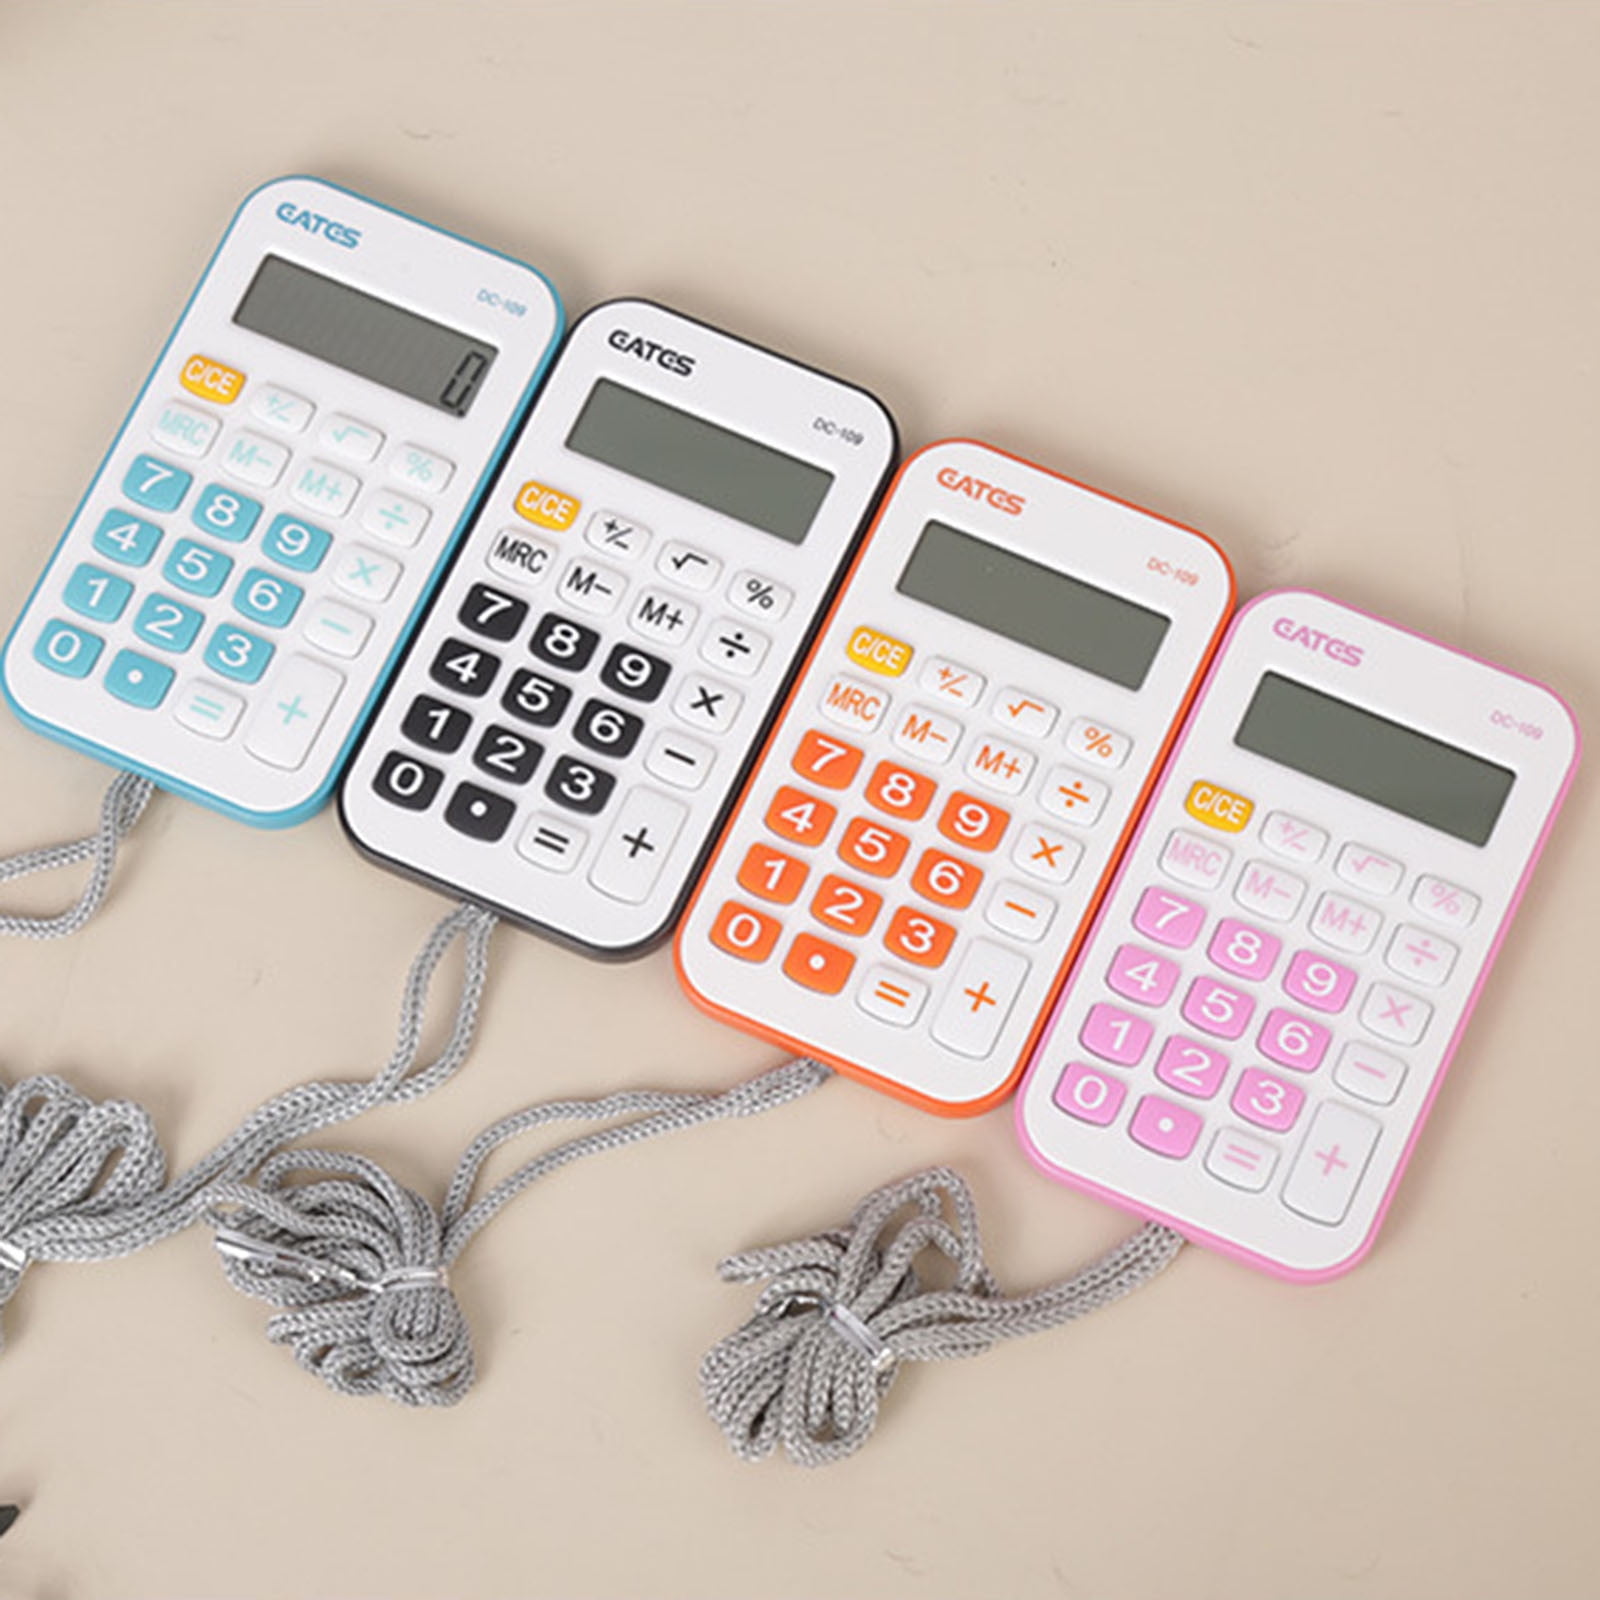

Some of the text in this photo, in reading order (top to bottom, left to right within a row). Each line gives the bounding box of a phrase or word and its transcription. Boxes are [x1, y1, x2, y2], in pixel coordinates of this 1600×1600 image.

[185, 359, 236, 395] C/CE
[159, 410, 209, 445] MRC
[300, 469, 341, 497] M+
[812, 417, 865, 446] DC-109
[139, 462, 173, 493] 7
[205, 494, 240, 527] 8
[275, 523, 311, 556] 9
[521, 486, 573, 523] C/CE
[106, 523, 140, 551] 4
[176, 548, 213, 581] 5
[248, 579, 283, 612] 6
[495, 535, 548, 574] MRC
[638, 597, 683, 630] M+
[47, 630, 82, 663] 0
[88, 578, 109, 607] 1
[149, 603, 185, 638] 2
[220, 634, 253, 667] 3
[477, 591, 512, 623] 7
[545, 623, 580, 657] 8
[616, 653, 651, 687] 9
[852, 632, 905, 669] C/CE
[445, 653, 480, 683] 4
[517, 677, 554, 712] 5
[589, 709, 625, 743] 6
[828, 683, 880, 721] MRC
[976, 745, 1020, 777] M+
[389, 762, 424, 796] 0
[429, 709, 450, 739] 1
[486, 735, 526, 773] 2
[560, 766, 596, 800] 3
[811, 738, 847, 772] 7
[880, 772, 916, 807] 8
[954, 803, 990, 838] 9
[781, 802, 815, 833] 4
[854, 827, 892, 862] 5
[928, 860, 964, 895] 6
[1193, 786, 1246, 824] C/CE
[726, 913, 761, 948] 0
[764, 859, 787, 890] 1
[824, 886, 864, 924] 2
[900, 918, 936, 953] 3
[1167, 837, 1221, 876] MRC
[1320, 900, 1364, 935] M+
[1153, 902, 1189, 937] 7
[1227, 930, 1263, 966] 8
[1302, 962, 1338, 997] 9
[1125, 961, 1159, 992] 4
[1201, 988, 1238, 1023] 5
[1277, 1021, 1313, 1056] 6
[1073, 1075, 1108, 1110] 0
[1111, 1020, 1131, 1051] 1
[1172, 1047, 1212, 1086] 2
[1250, 1080, 1286, 1116] 3
